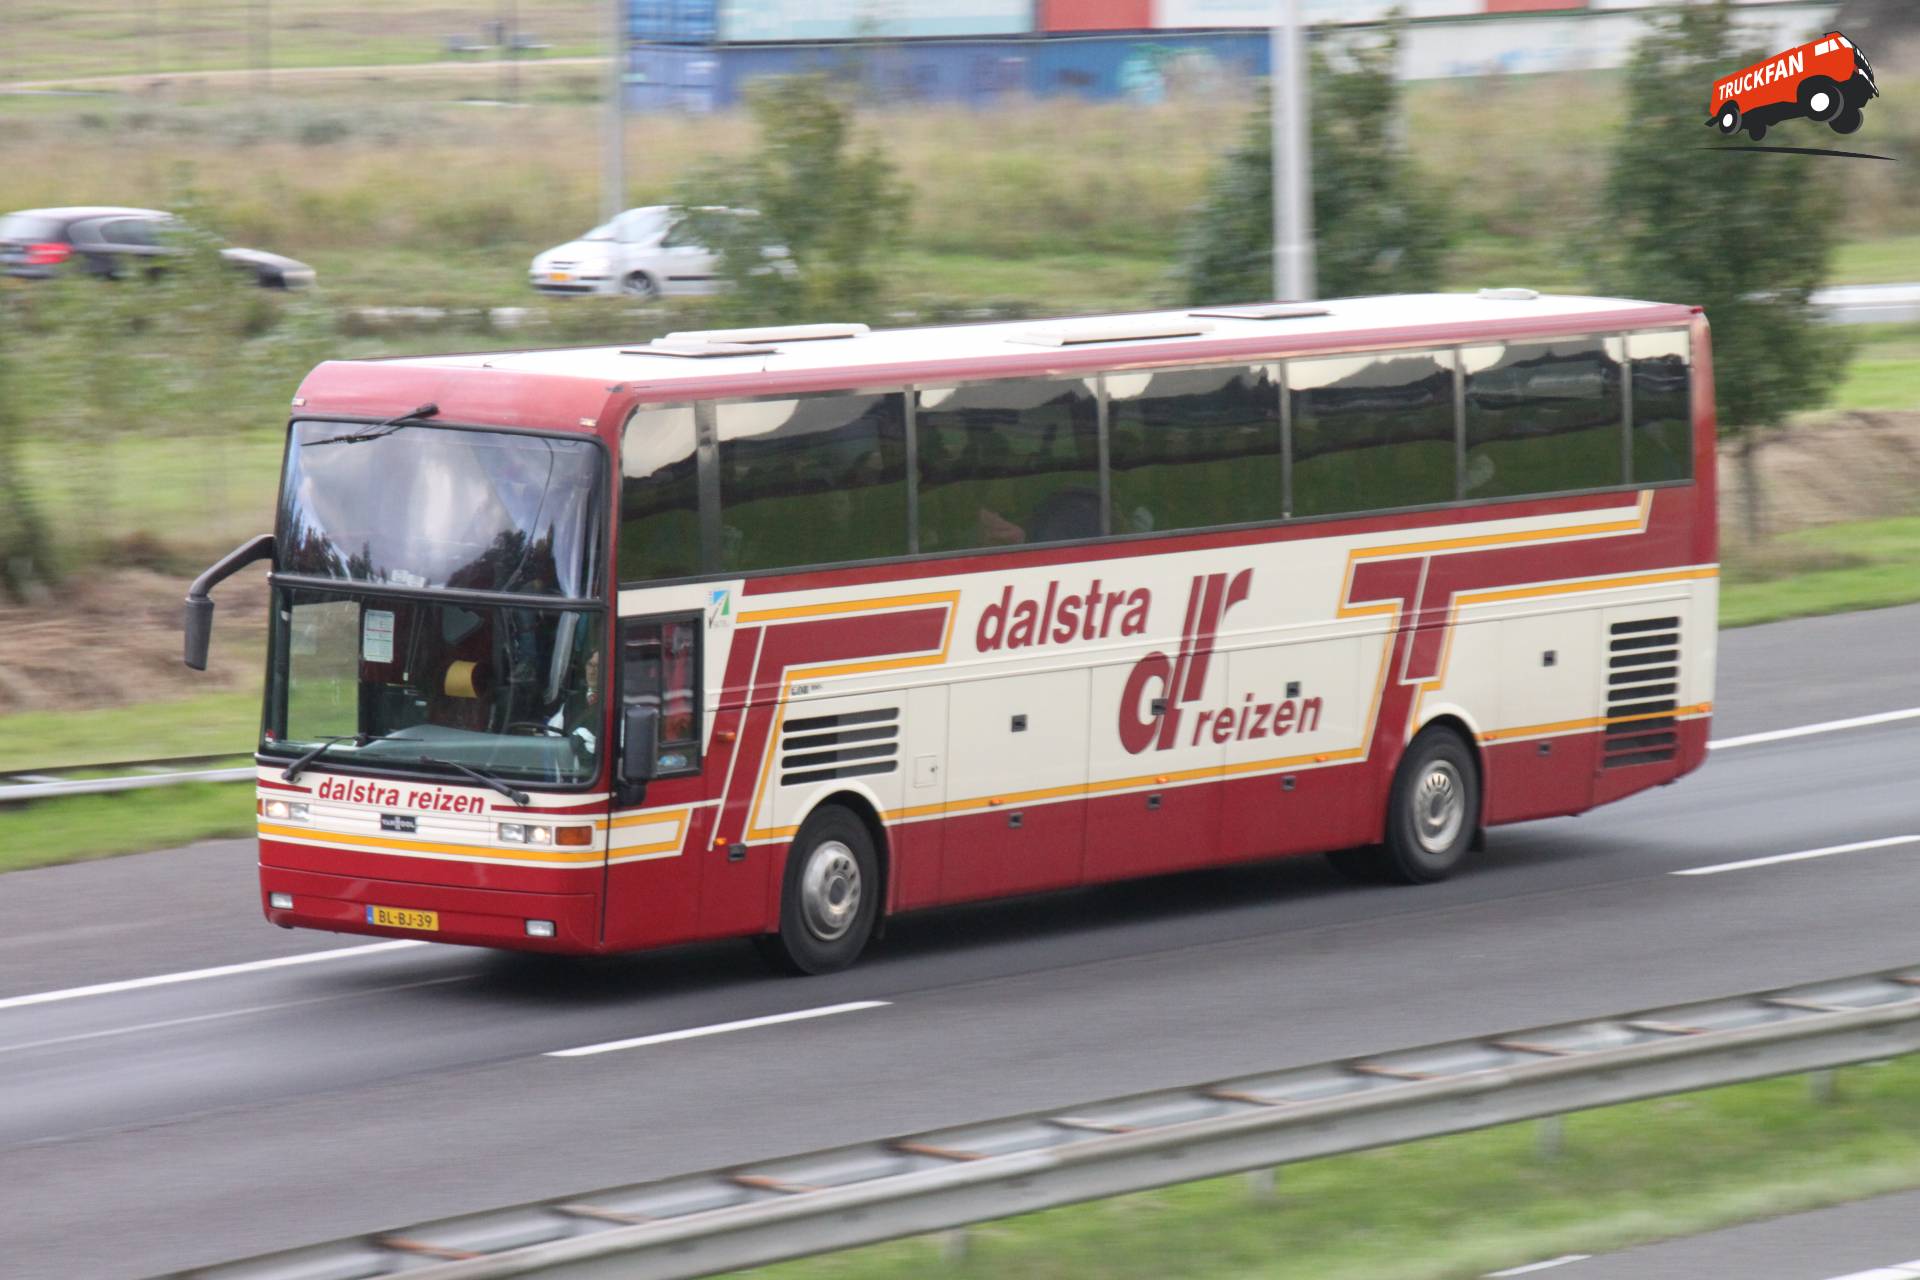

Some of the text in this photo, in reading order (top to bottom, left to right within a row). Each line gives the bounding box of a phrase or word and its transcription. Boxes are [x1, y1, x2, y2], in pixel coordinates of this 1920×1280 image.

[975, 579, 1152, 653] dalstra
[1191, 692, 1324, 747] reizen
[318, 777, 485, 814] dalstra reizen
[379, 910, 432, 928] BL-BJ-39
